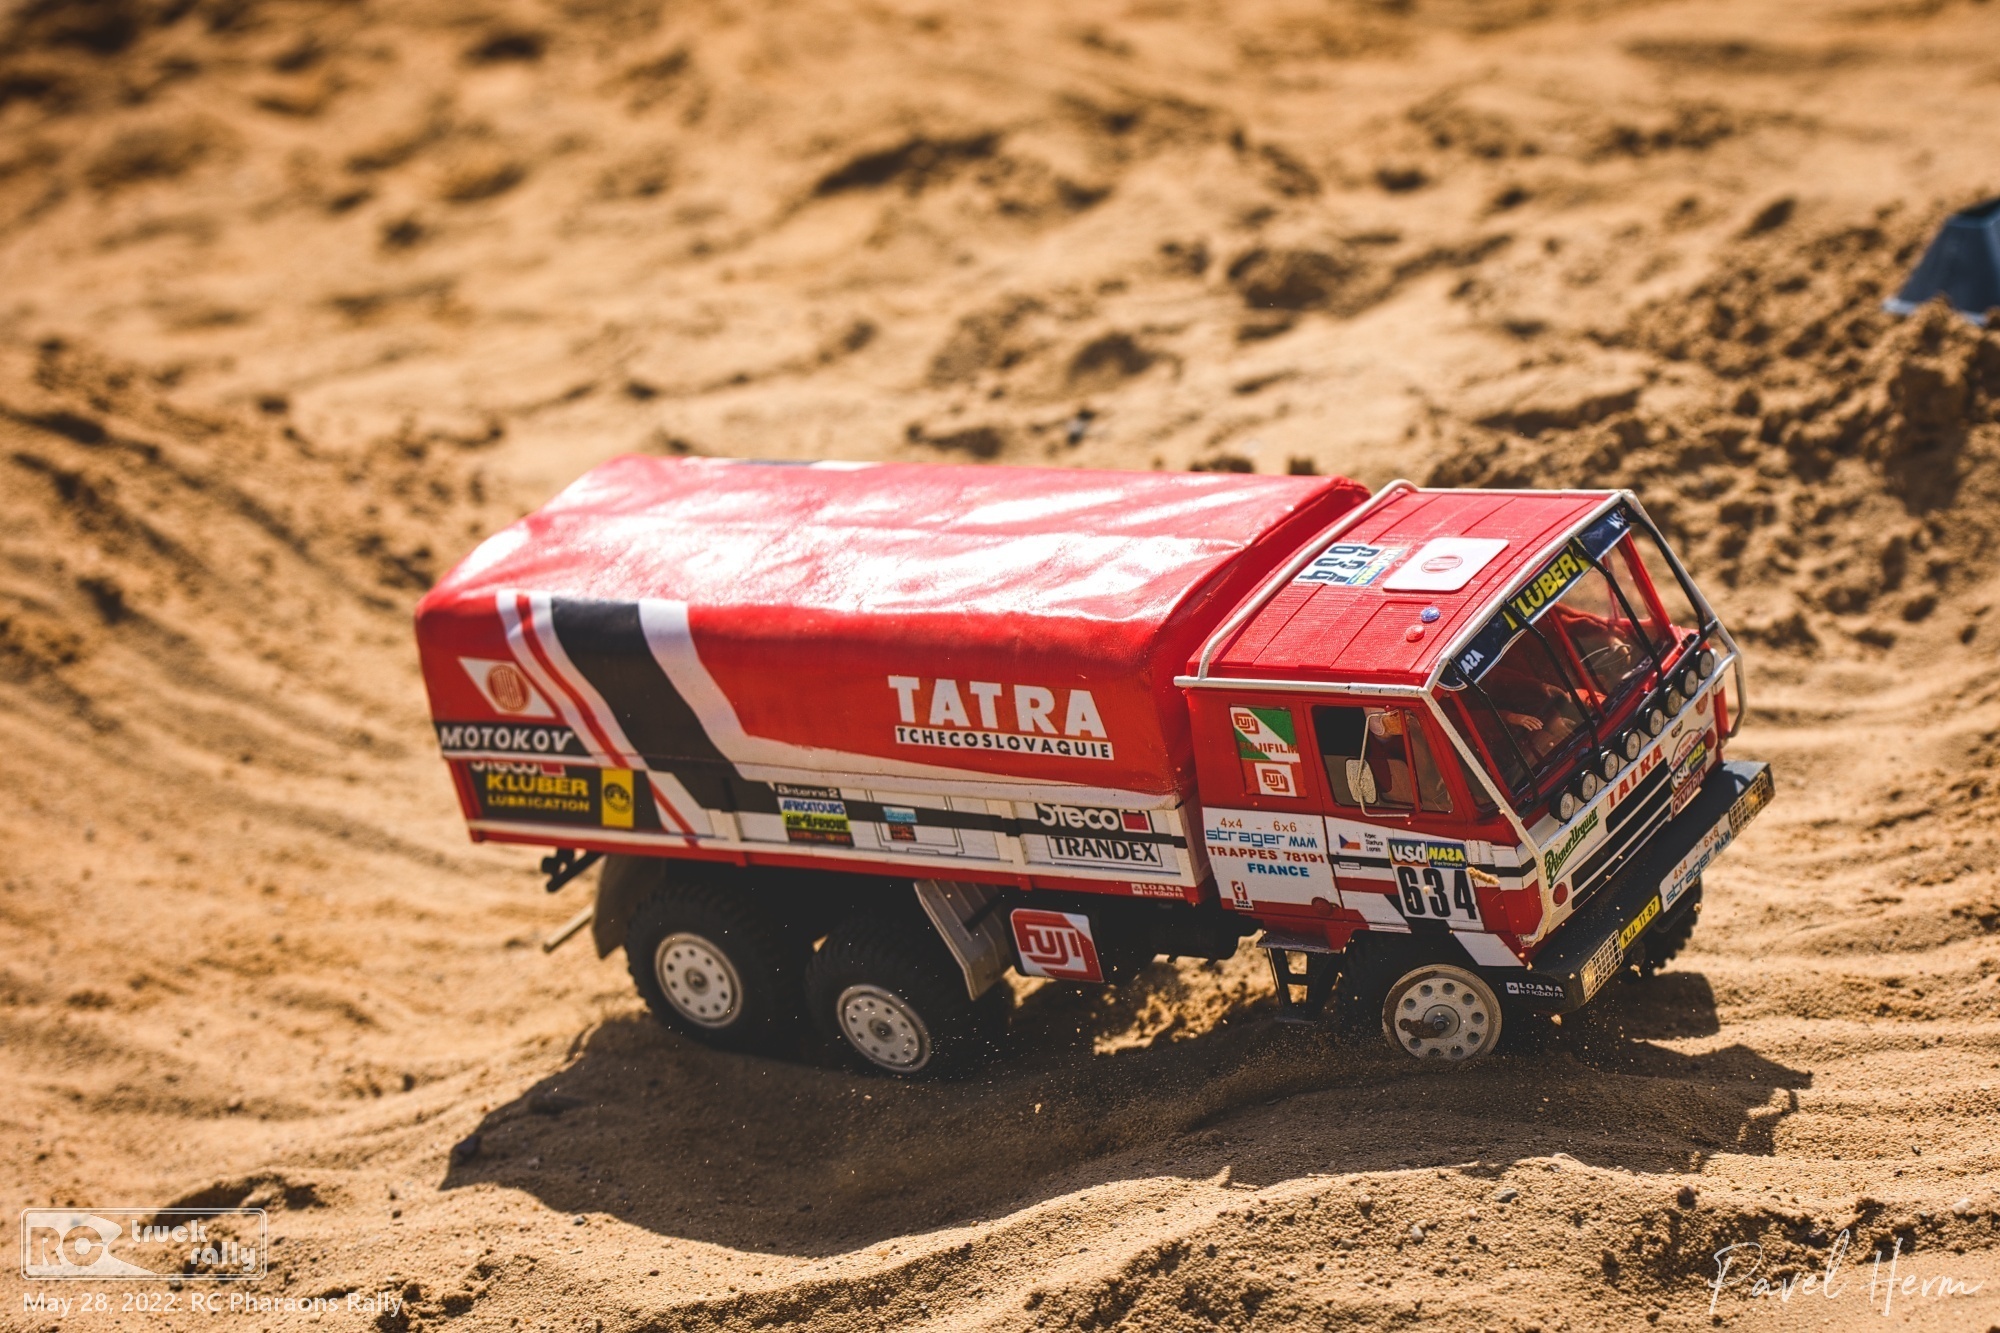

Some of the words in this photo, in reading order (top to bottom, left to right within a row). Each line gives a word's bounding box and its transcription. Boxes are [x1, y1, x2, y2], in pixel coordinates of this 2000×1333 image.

[1298, 545, 1380, 583] 634
[888, 675, 1108, 738] TATRA
[441, 726, 573, 752] MOTOKOV
[897, 728, 1109, 759] TCHECOSLOVAQUIE
[1240, 741, 1298, 754] FUJIFILM
[487, 794, 590, 812] LUBRICATION
[1220, 817, 1243, 829] 4x4
[1273, 820, 1297, 832] 6x6
[1206, 827, 1285, 848] strager
[1289, 836, 1318, 848] MAM
[1051, 836, 1158, 863] TRANDEX
[1208, 846, 1278, 860] TRAPPES
[1283, 851, 1325, 863] 78191
[1247, 863, 1310, 877] FRANCE
[1142, 883, 1183, 892] LOANA
[1397, 866, 1477, 920] 634
[1518, 982, 1564, 992] LOANA
